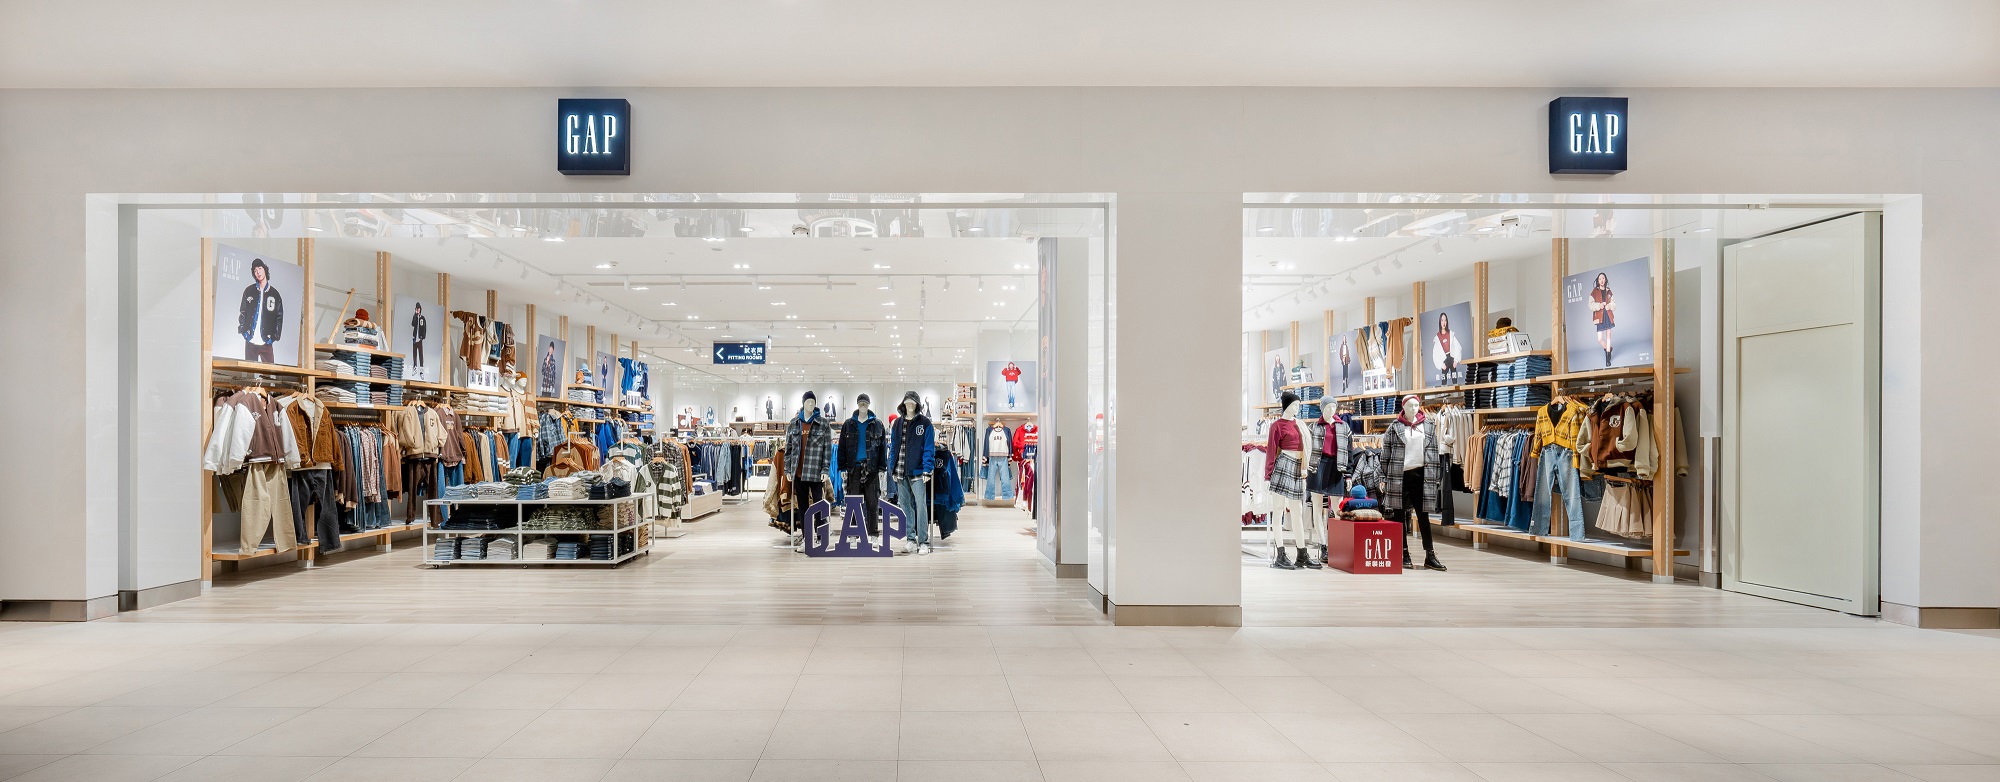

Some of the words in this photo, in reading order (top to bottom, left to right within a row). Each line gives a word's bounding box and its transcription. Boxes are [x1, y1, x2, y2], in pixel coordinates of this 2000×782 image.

[567, 114, 617, 154] GAP
[1569, 113, 1619, 154] GAP
[223, 256, 241, 275] GAP
[1567, 282, 1583, 299] GAP
[915, 424, 925, 436] G
[1609, 414, 1621, 428] G
[804, 494, 907, 558] GAP
[1365, 538, 1392, 560] GAP
